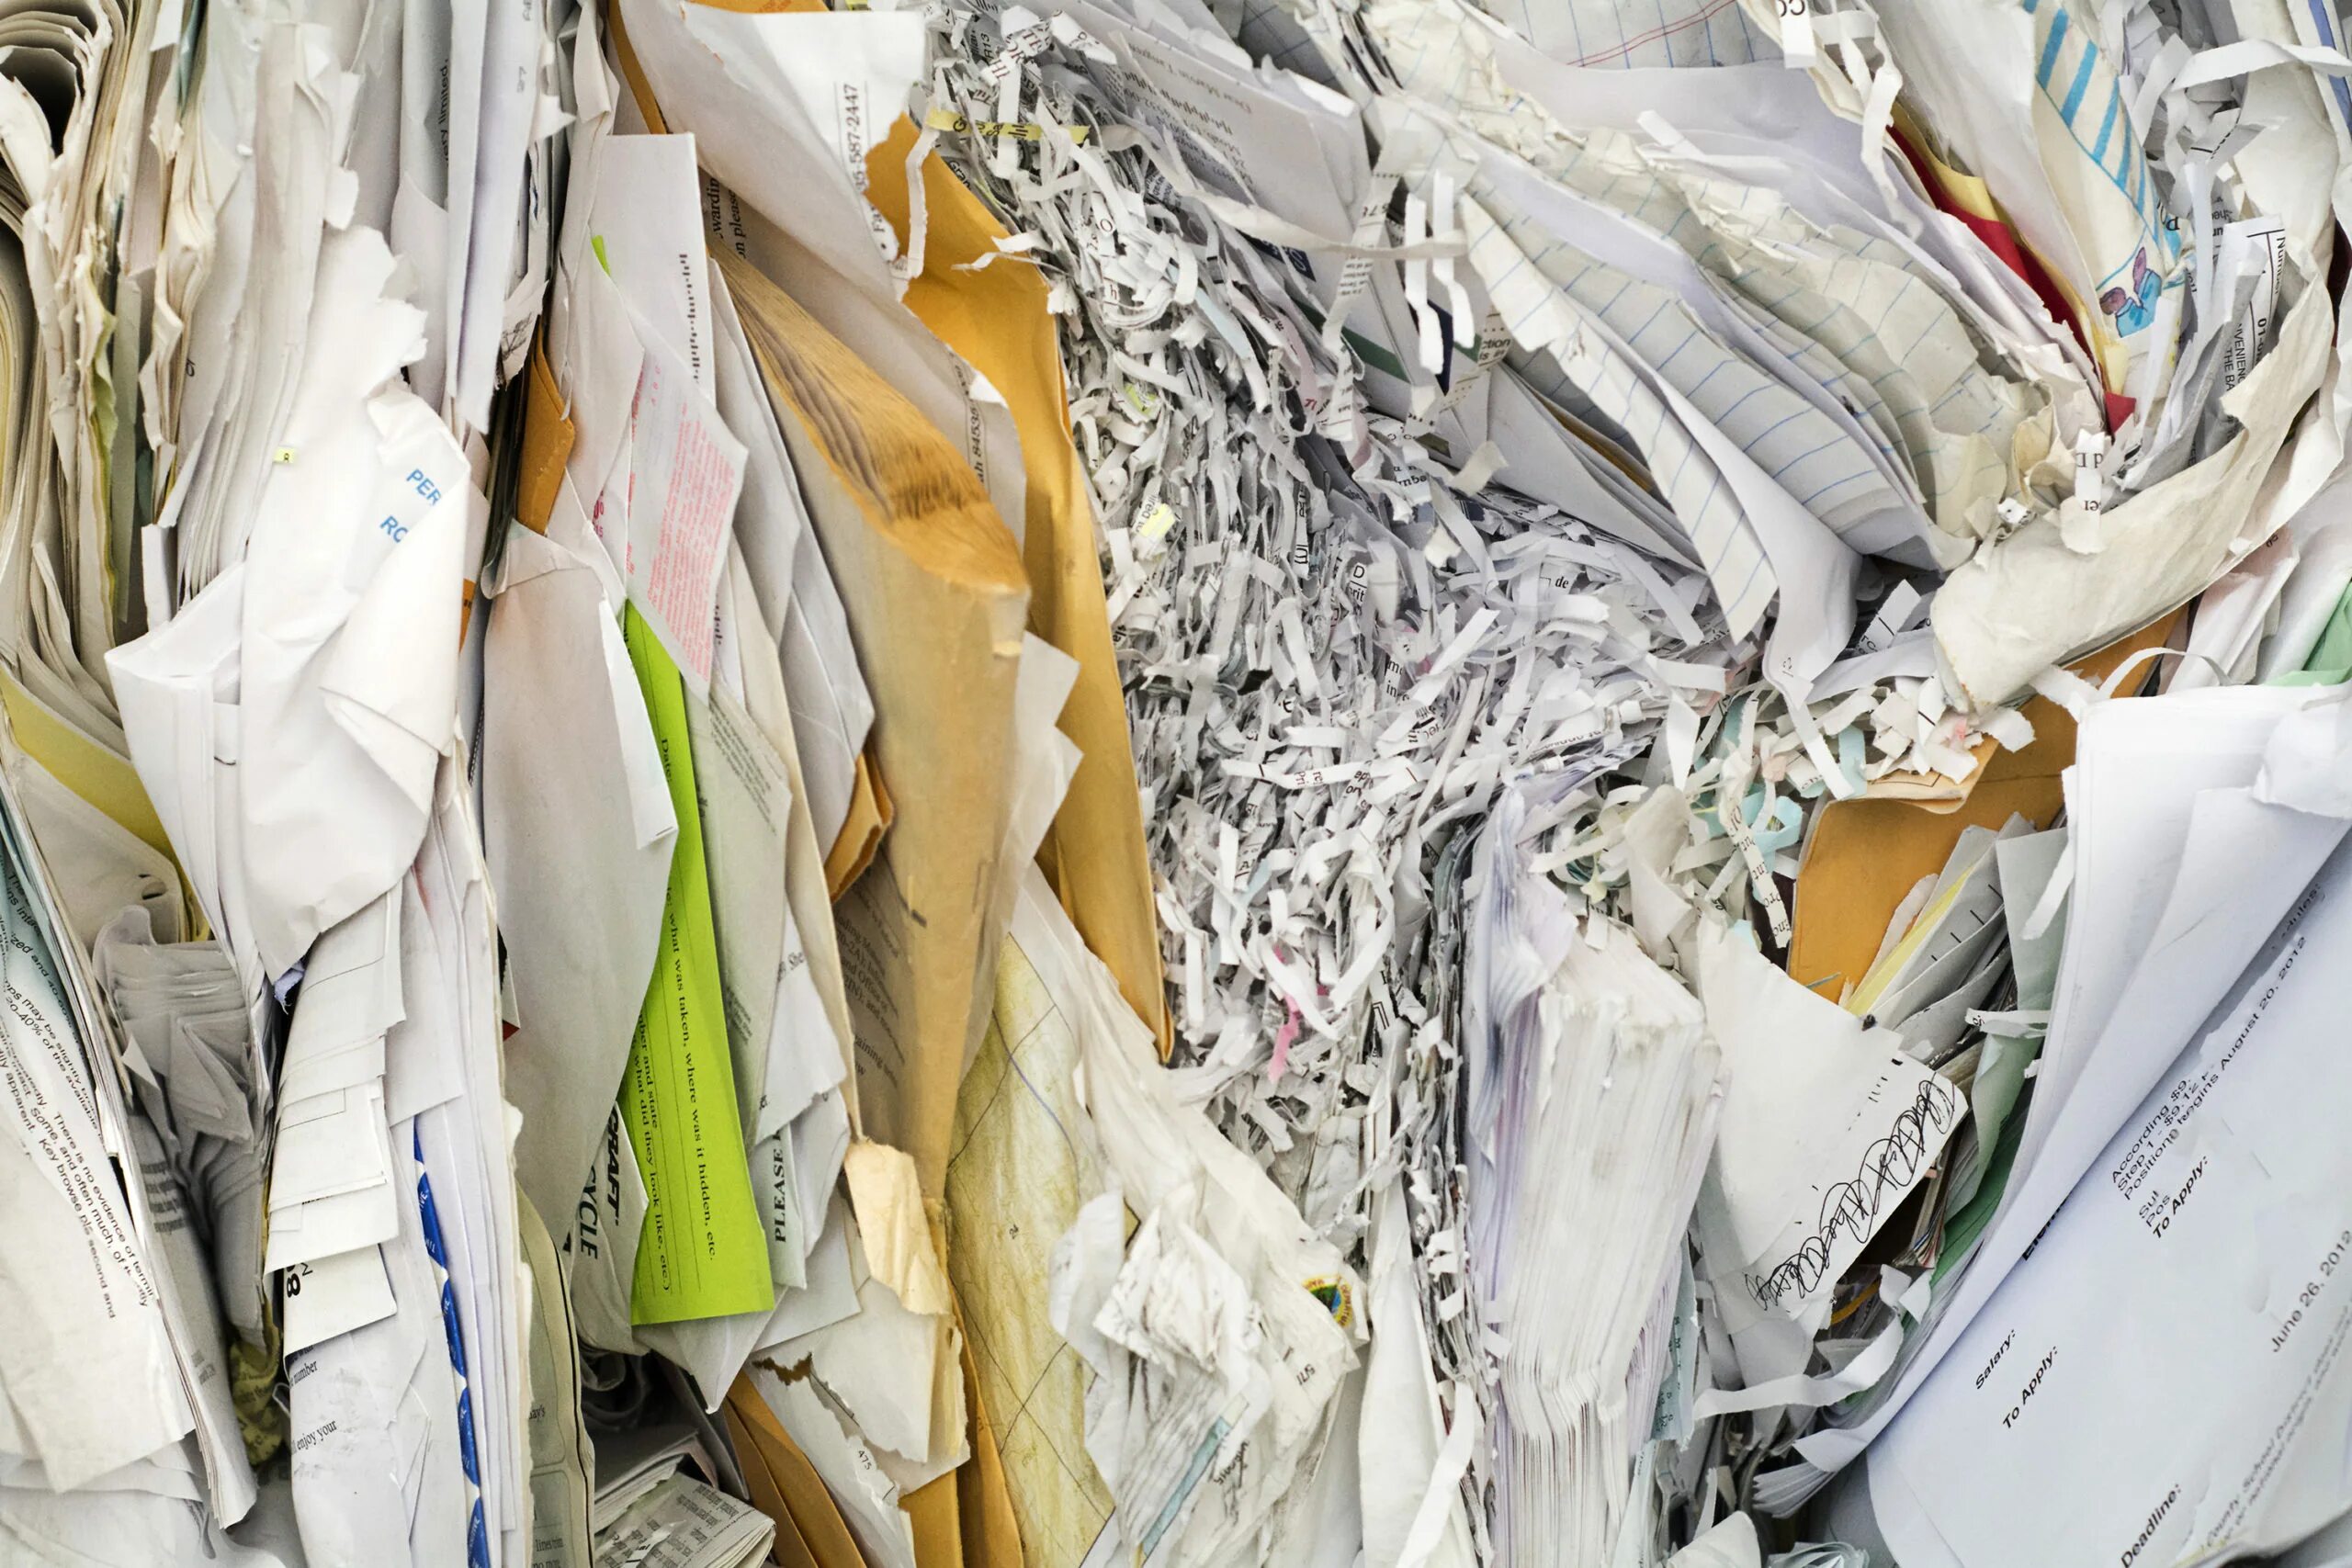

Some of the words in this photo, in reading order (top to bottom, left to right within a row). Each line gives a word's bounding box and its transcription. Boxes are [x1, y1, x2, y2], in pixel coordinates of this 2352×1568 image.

[660, 738, 673, 783] Date:
[668, 911, 680, 953] what
[673, 957, 685, 992] was
[21, 998, 46, 1022] may
[43, 1022, 57, 1041] be
[678, 995, 691, 1047] taken,
[2220, 1012, 2261, 1071] August
[2278, 935, 2307, 981] 2012
[42, 1037, 55, 1052] of
[51, 1051, 66, 1073] the
[64, 1074, 98, 1131] available
[634, 1054, 644, 1097] what
[643, 1056, 653, 1087] and
[648, 1090, 659, 1130] state
[684, 1052, 697, 1104] where
[640, 1098, 650, 1126] did
[691, 1108, 701, 1143] was
[643, 1130, 654, 1168] they
[695, 1147, 704, 1159] it
[2110, 1103, 2171, 1184] According
[51, 1110, 78, 1150] There
[74, 1152, 85, 1165] is
[82, 1166, 96, 1184] no
[91, 1185, 128, 1244] evidence
[124, 1245, 137, 1259] of
[649, 1171, 660, 1208] look
[697, 1163, 713, 1227] hidden,
[773, 1147, 787, 1243] PLEASE
[2117, 1153, 2146, 1192] Step
[59, 1146, 78, 1172] and
[73, 1172, 95, 1207] often
[90, 1208, 115, 1249] much,
[112, 1250, 127, 1264] of
[2152, 1216, 2172, 1240] To
[2171, 1155, 2210, 1216] Apply:
[38, 1137, 61, 1164] Key
[55, 1163, 84, 1213] browse
[87, 1239, 109, 1291] second
[102, 1292, 117, 1320] and
[654, 1213, 664, 1250] like,
[707, 1230, 716, 1261] etc.
[2269, 1308, 2303, 1353] June
[2319, 1230, 2352, 1278] 2012
[293, 1359, 319, 1385] number
[1974, 1328, 2017, 1391] Salary:
[2002, 1405, 2021, 1430] To
[2020, 1345, 2059, 1405] Apply:
[296, 1431, 317, 1452] enjoy
[315, 1419, 338, 1444] your
[857, 1449, 873, 1471] 475
[2120, 1483, 2183, 1568] Deadline:
